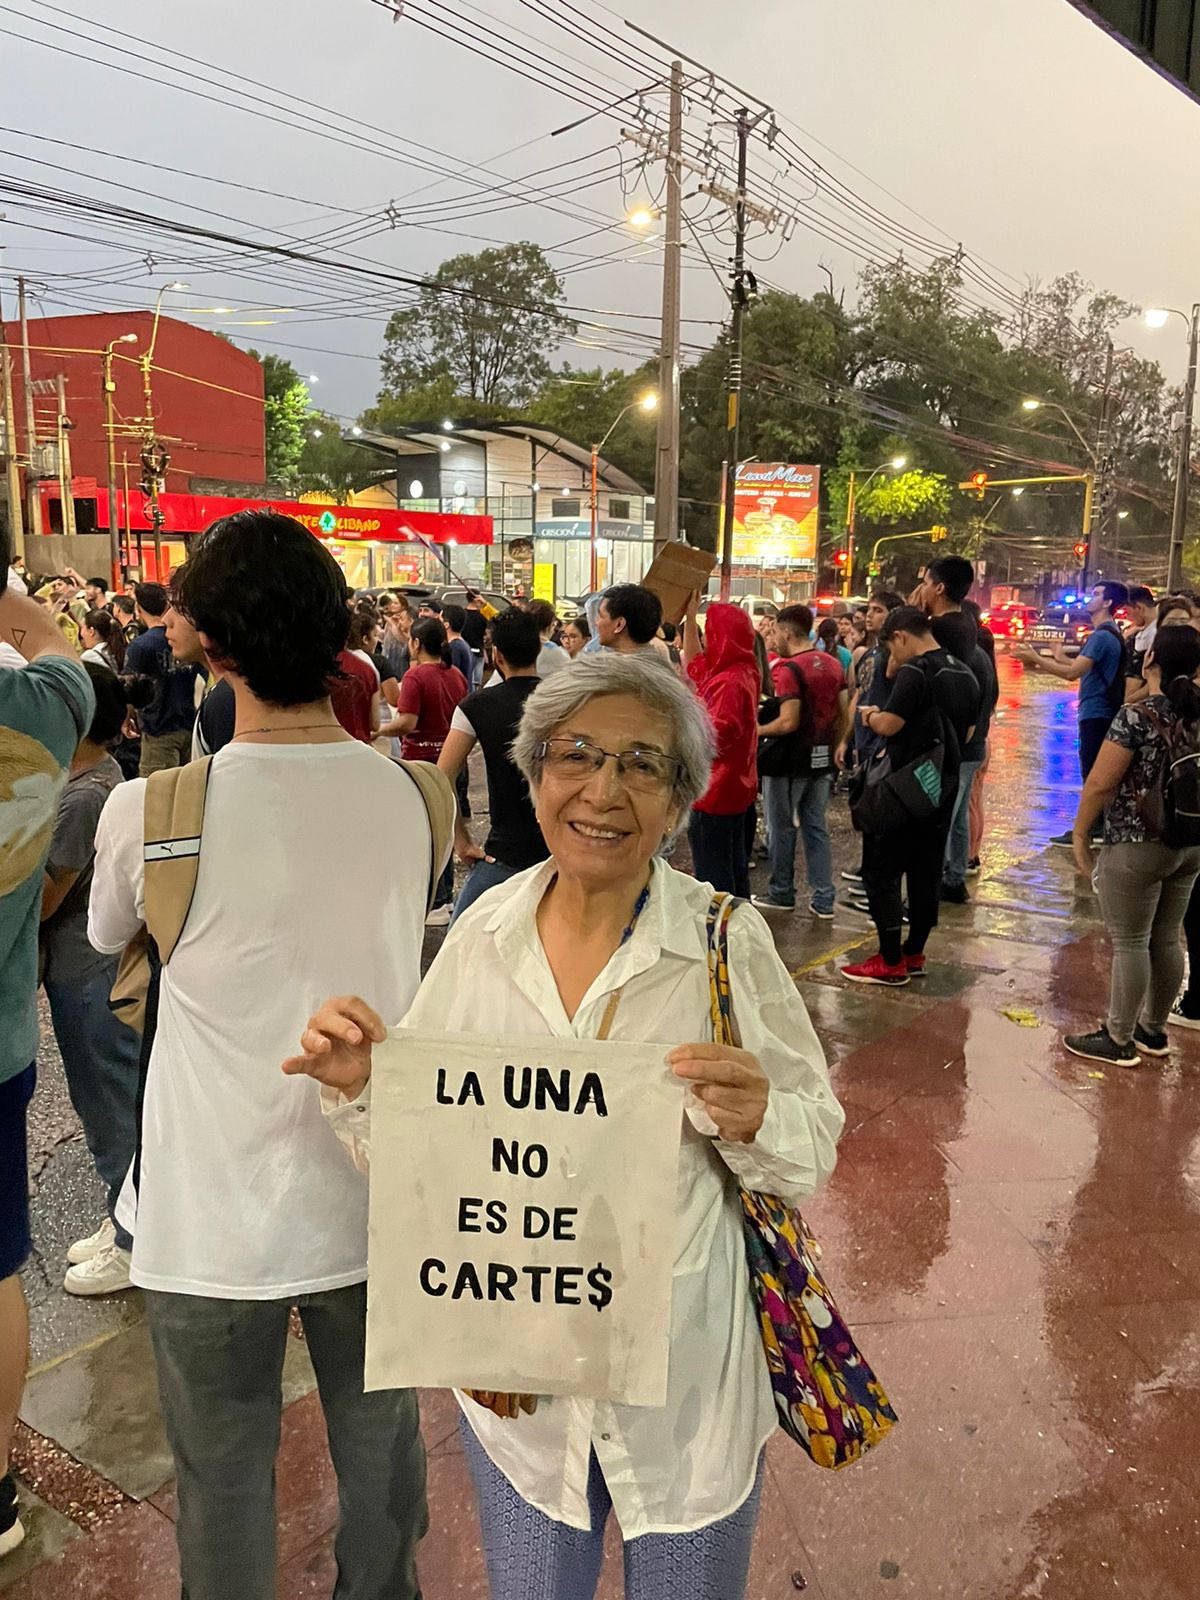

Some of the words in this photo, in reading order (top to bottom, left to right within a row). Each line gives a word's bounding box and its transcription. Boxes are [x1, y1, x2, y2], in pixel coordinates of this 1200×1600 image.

[1033, 630, 1066, 639] ISUZU
[436, 1068, 485, 1106] LA
[503, 1065, 608, 1117] UNA
[492, 1137, 549, 1179] NO
[458, 1197, 508, 1234] ES
[523, 1206, 578, 1241] DE
[419, 1258, 613, 1312] CARTE$
